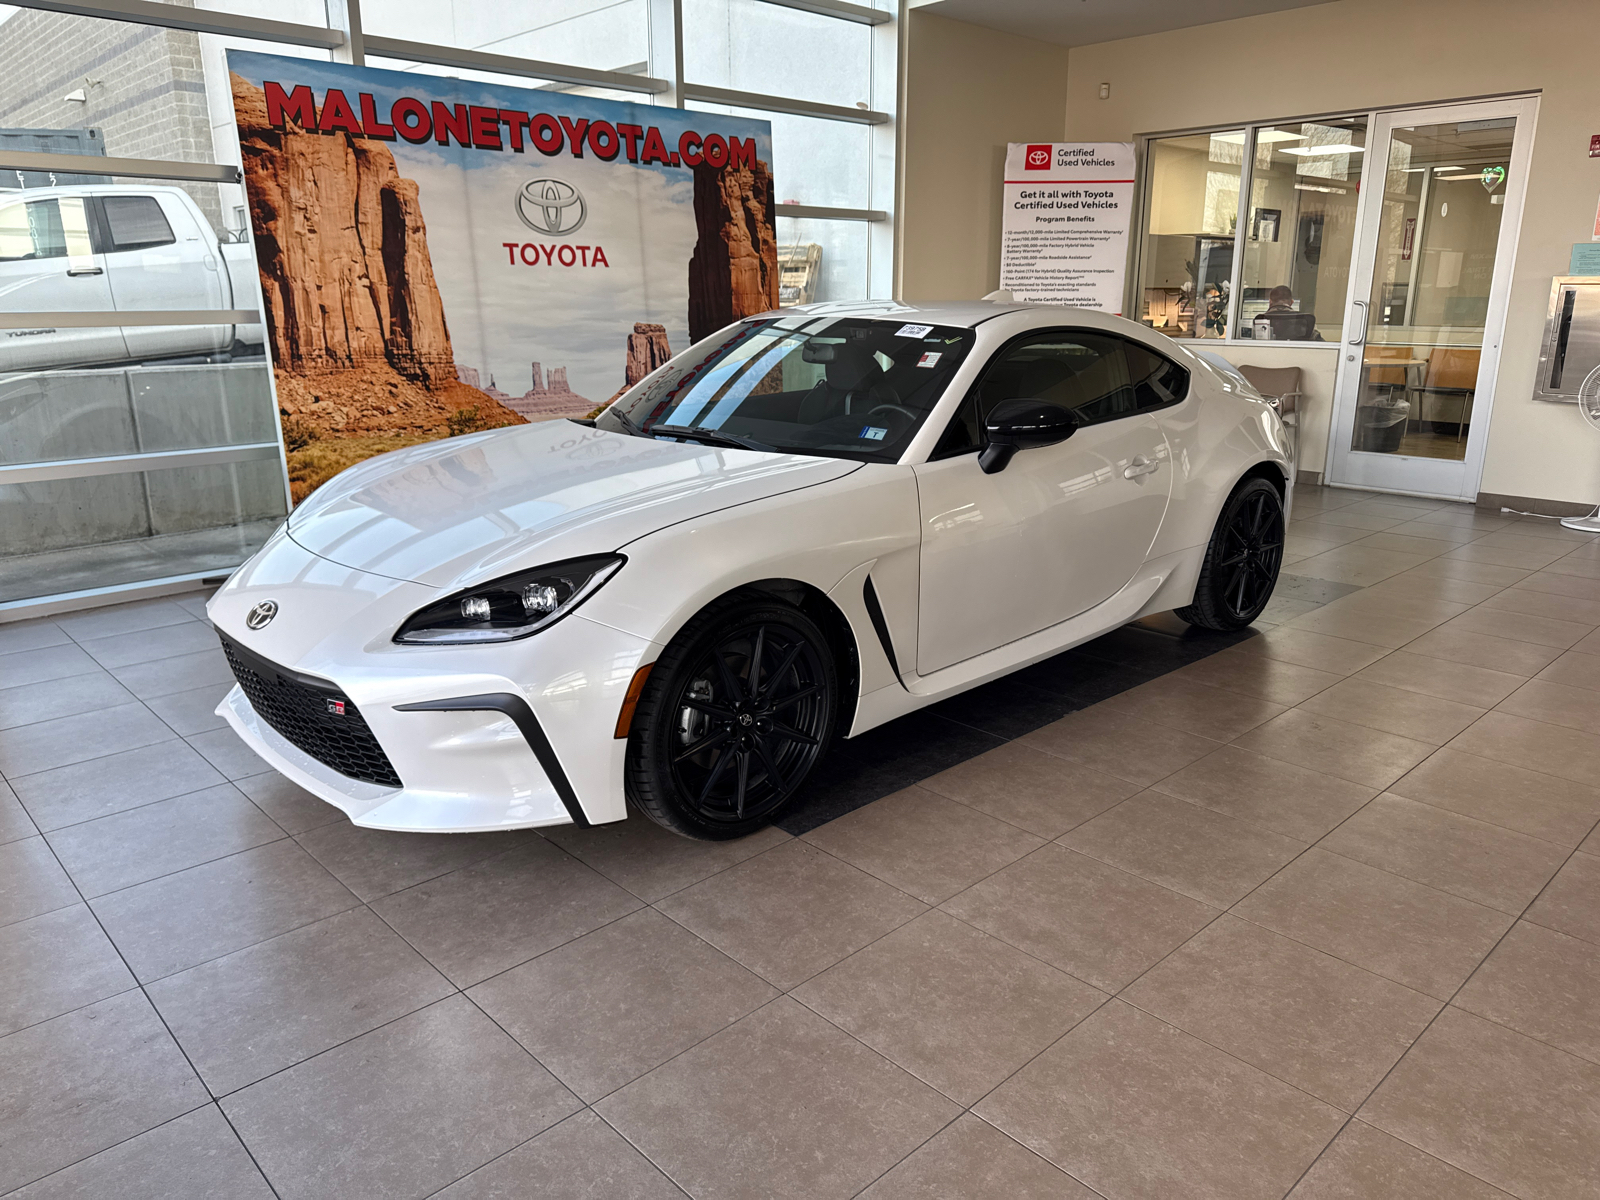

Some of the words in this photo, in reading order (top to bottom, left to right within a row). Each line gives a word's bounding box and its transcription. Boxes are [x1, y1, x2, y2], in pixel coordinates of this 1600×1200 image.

[263, 81, 758, 170] MALONETOYOTA.COM
[1058, 149, 1094, 157] Certified
[1084, 191, 1113, 200] Toyota
[502, 243, 610, 268] TOYOTA
